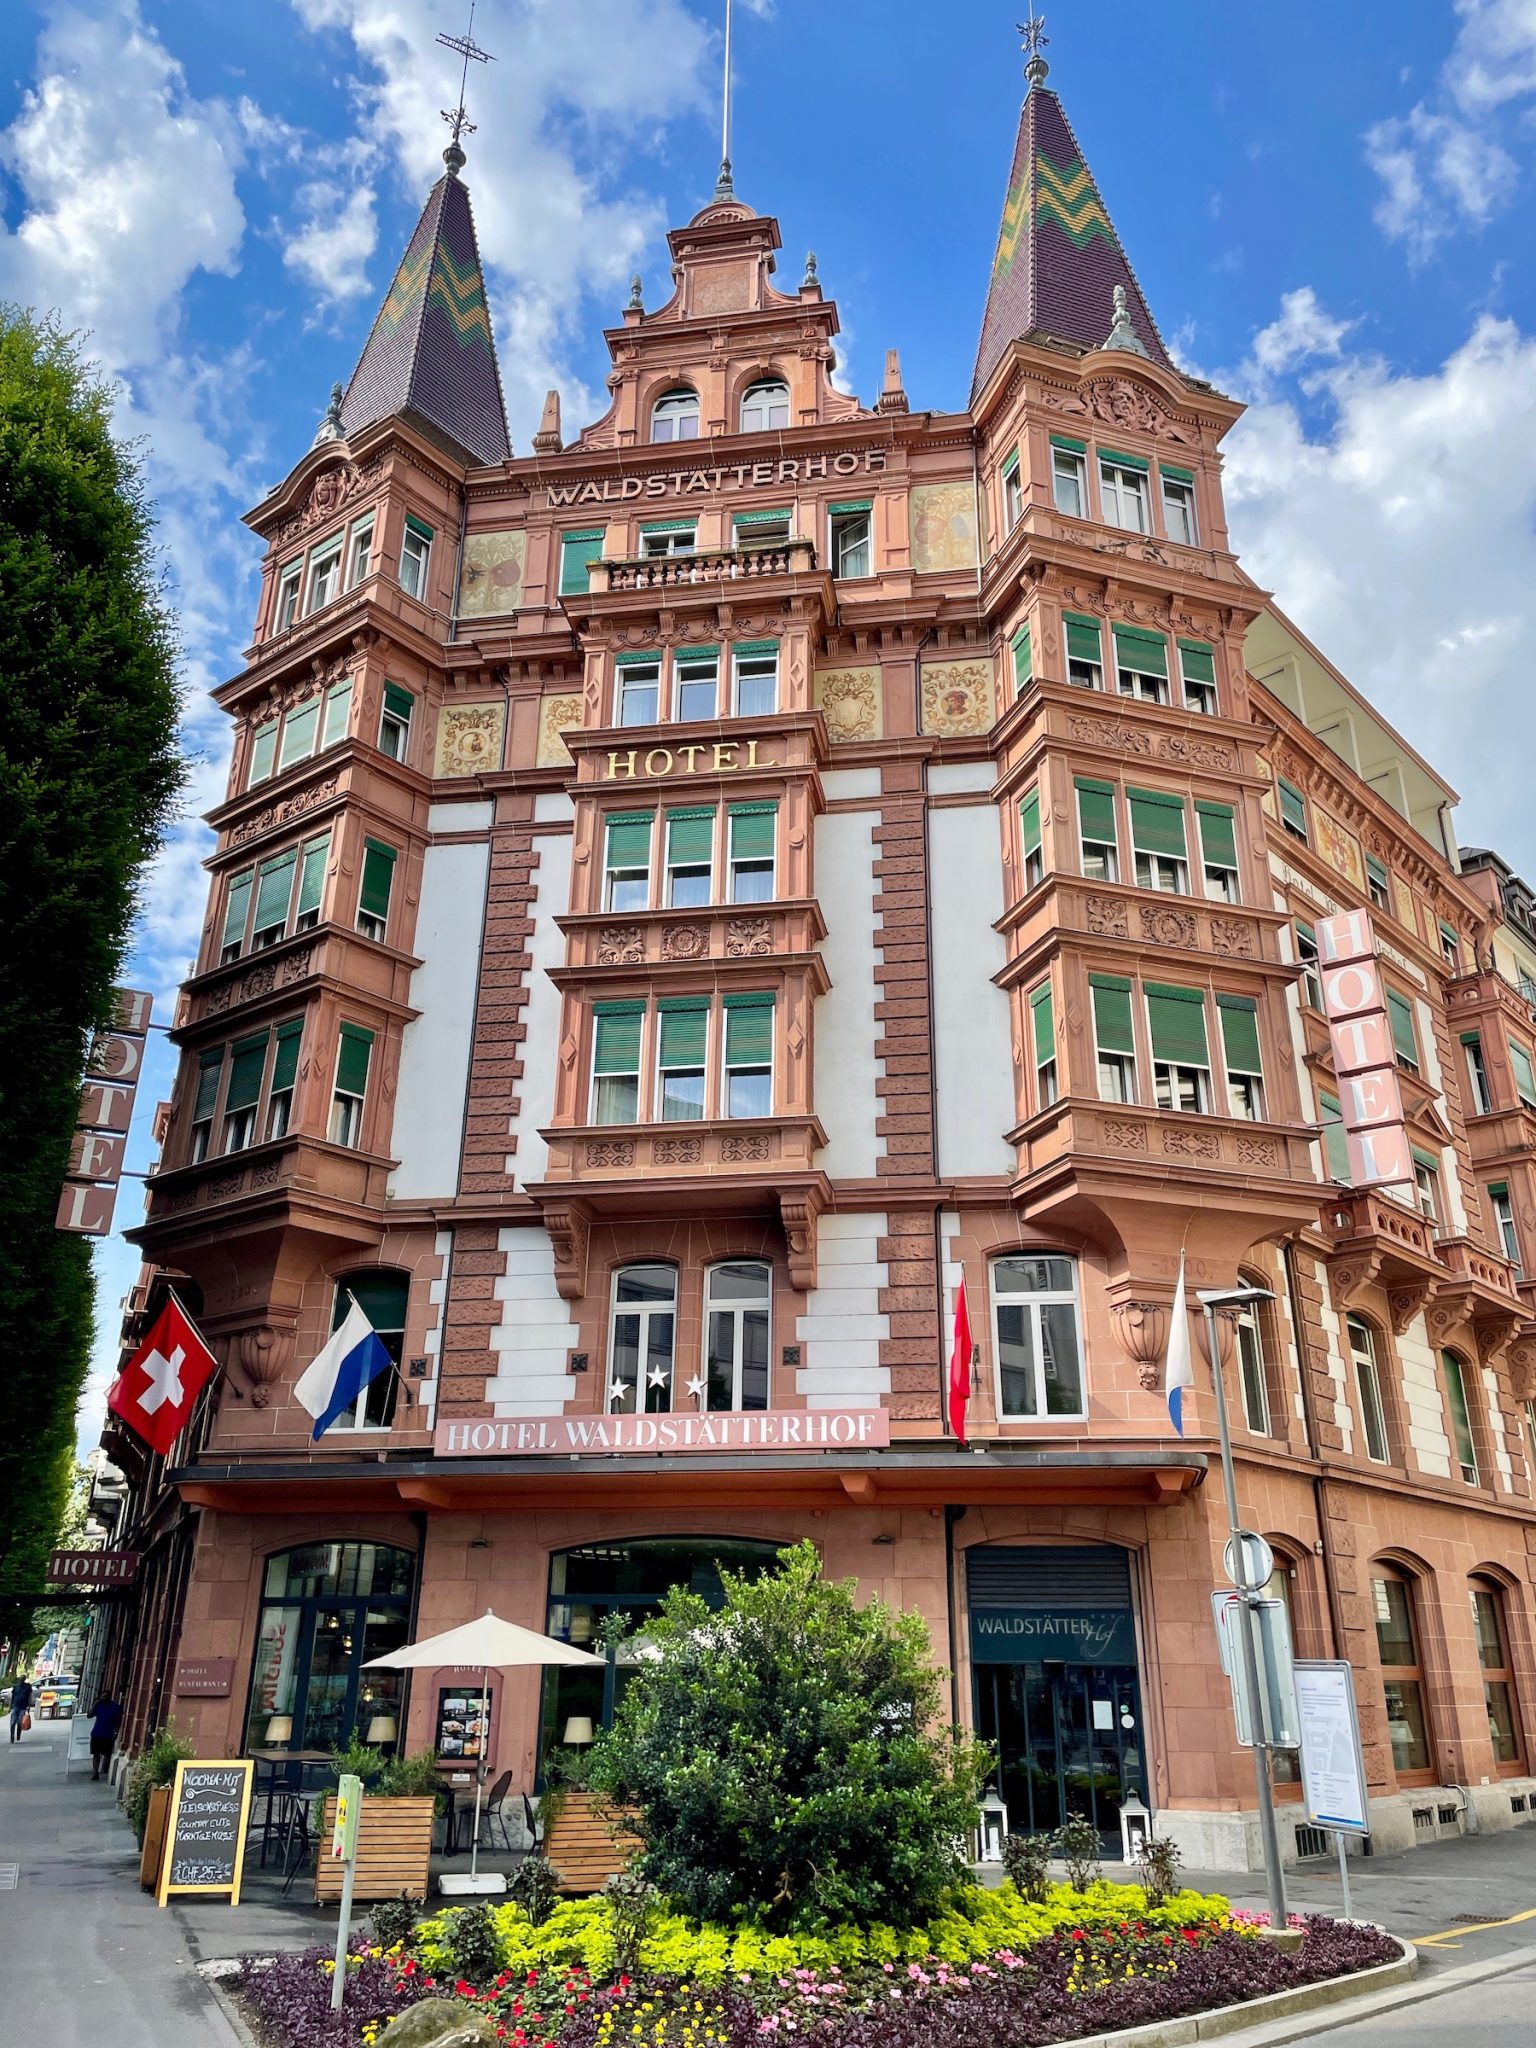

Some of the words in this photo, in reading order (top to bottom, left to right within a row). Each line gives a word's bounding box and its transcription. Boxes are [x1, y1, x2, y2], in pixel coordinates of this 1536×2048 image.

[606, 740, 778, 780] HOTEL
[1319, 912, 1400, 1182] HOTEL
[67, 992, 148, 1231] HOTEL
[446, 1422, 557, 1451] HOTEL
[565, 1414, 876, 1447] WALDSTÄTTERHOF
[52, 1558, 133, 1577] HOTEL
[181, 1865, 199, 1880] CHF
